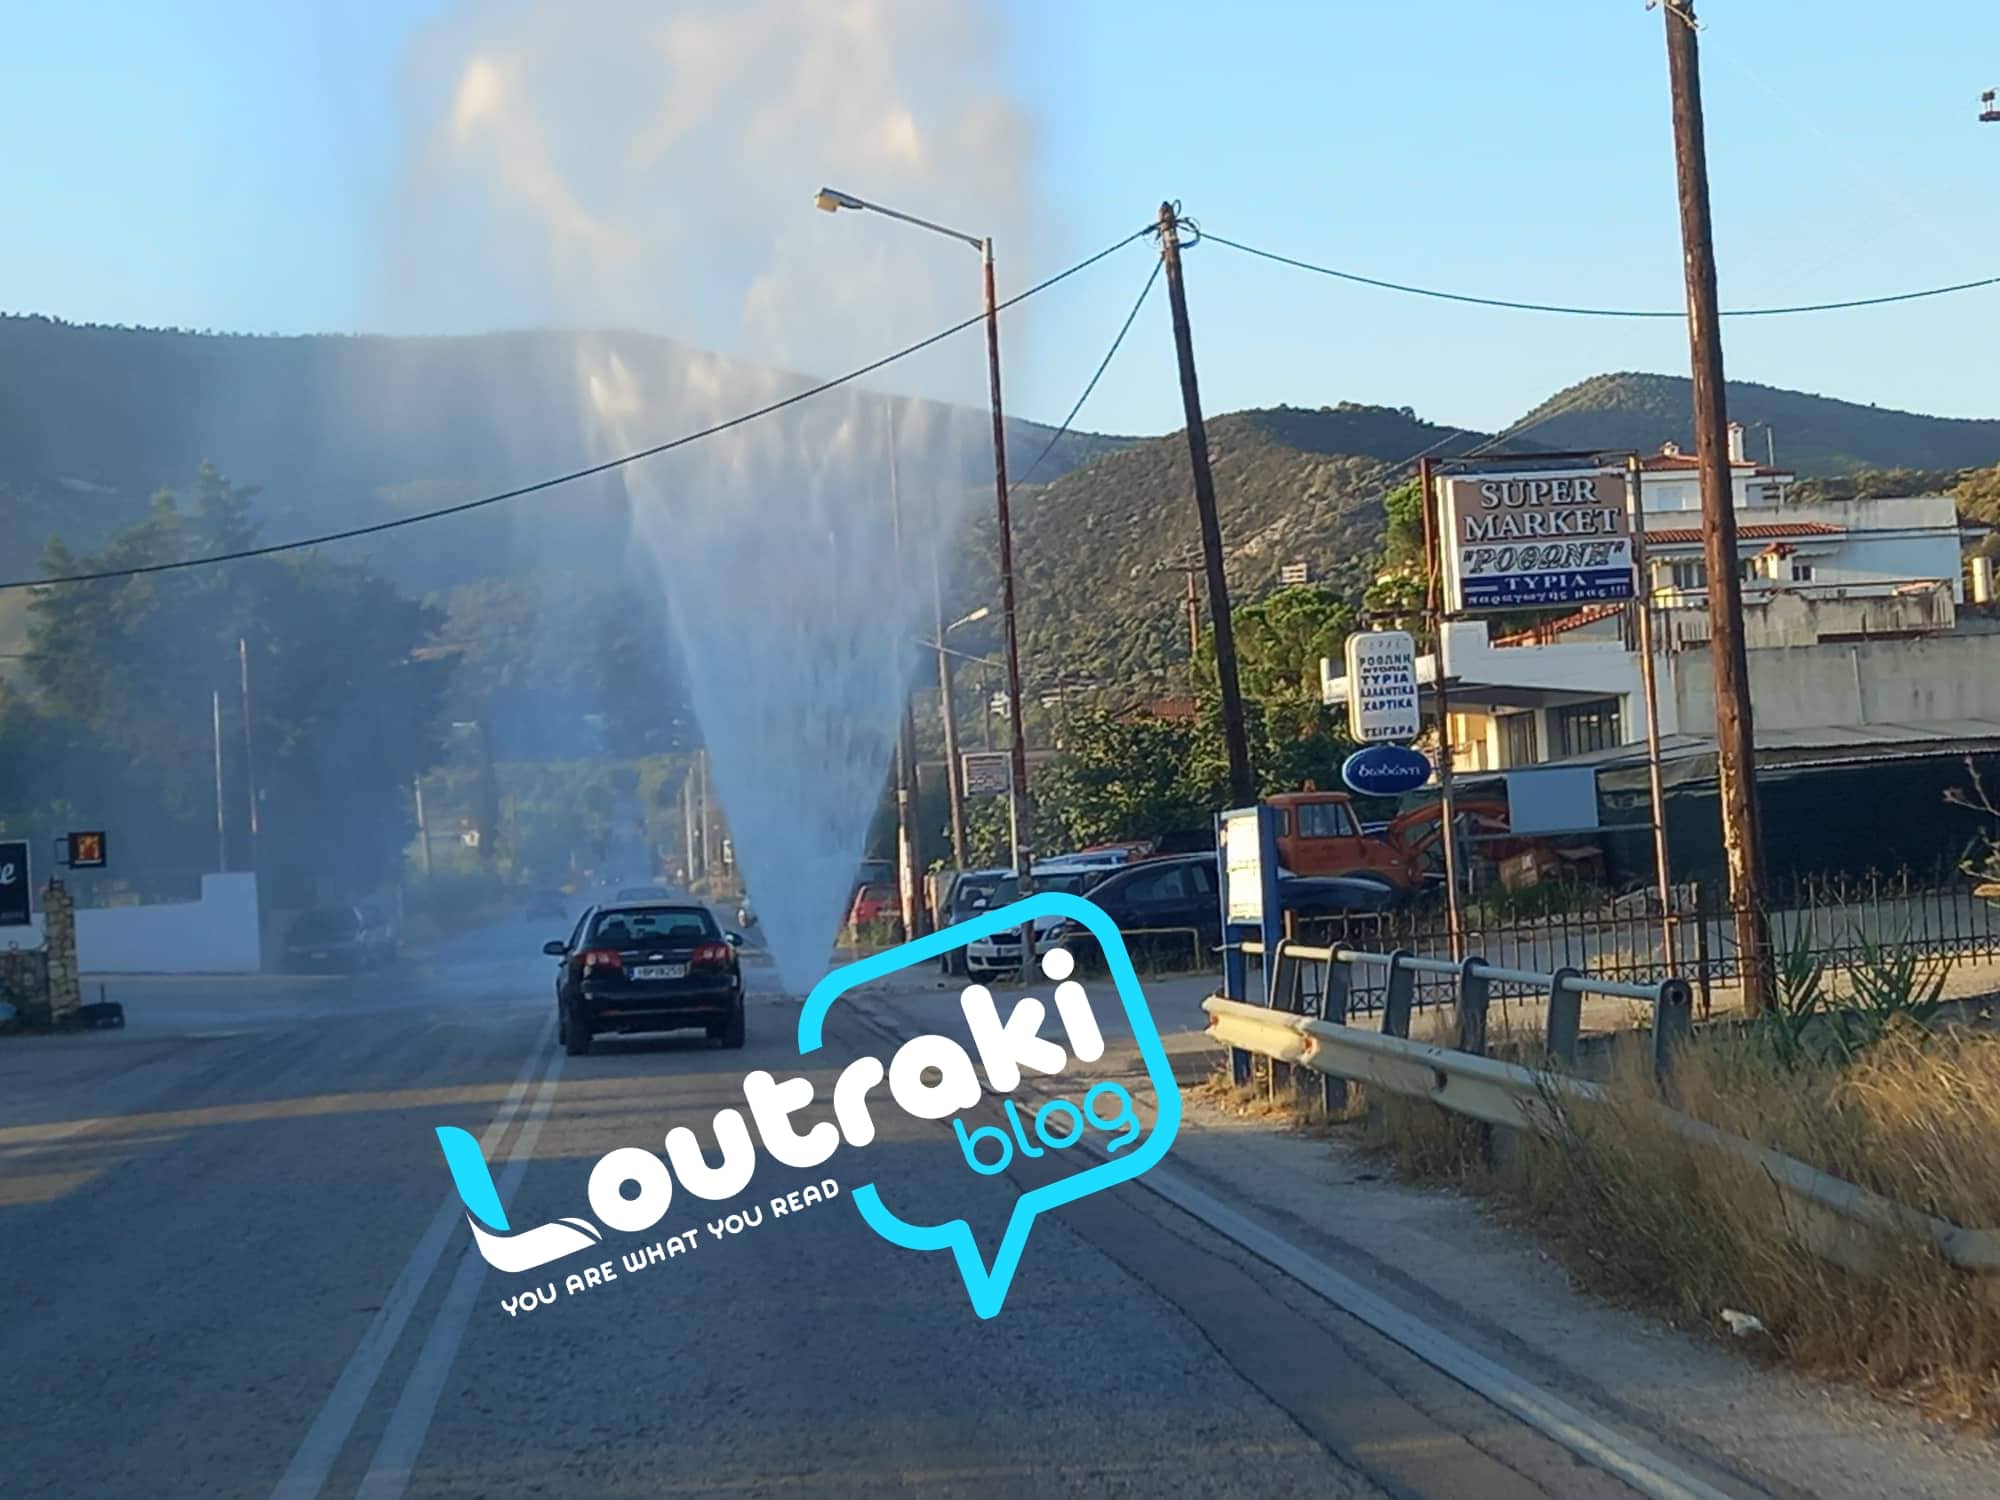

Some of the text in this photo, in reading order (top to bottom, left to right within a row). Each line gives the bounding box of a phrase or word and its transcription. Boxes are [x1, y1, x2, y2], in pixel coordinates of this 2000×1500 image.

[1480, 478, 1600, 509] SUPER
[1464, 508, 1621, 543] MARKET
[1504, 573, 1587, 591] ΤΥΡΙΑ
[1361, 673, 1409, 686] ΤΥΡΙΑ
[1363, 700, 1412, 712] ΧΑΡΤΙΚΑ
